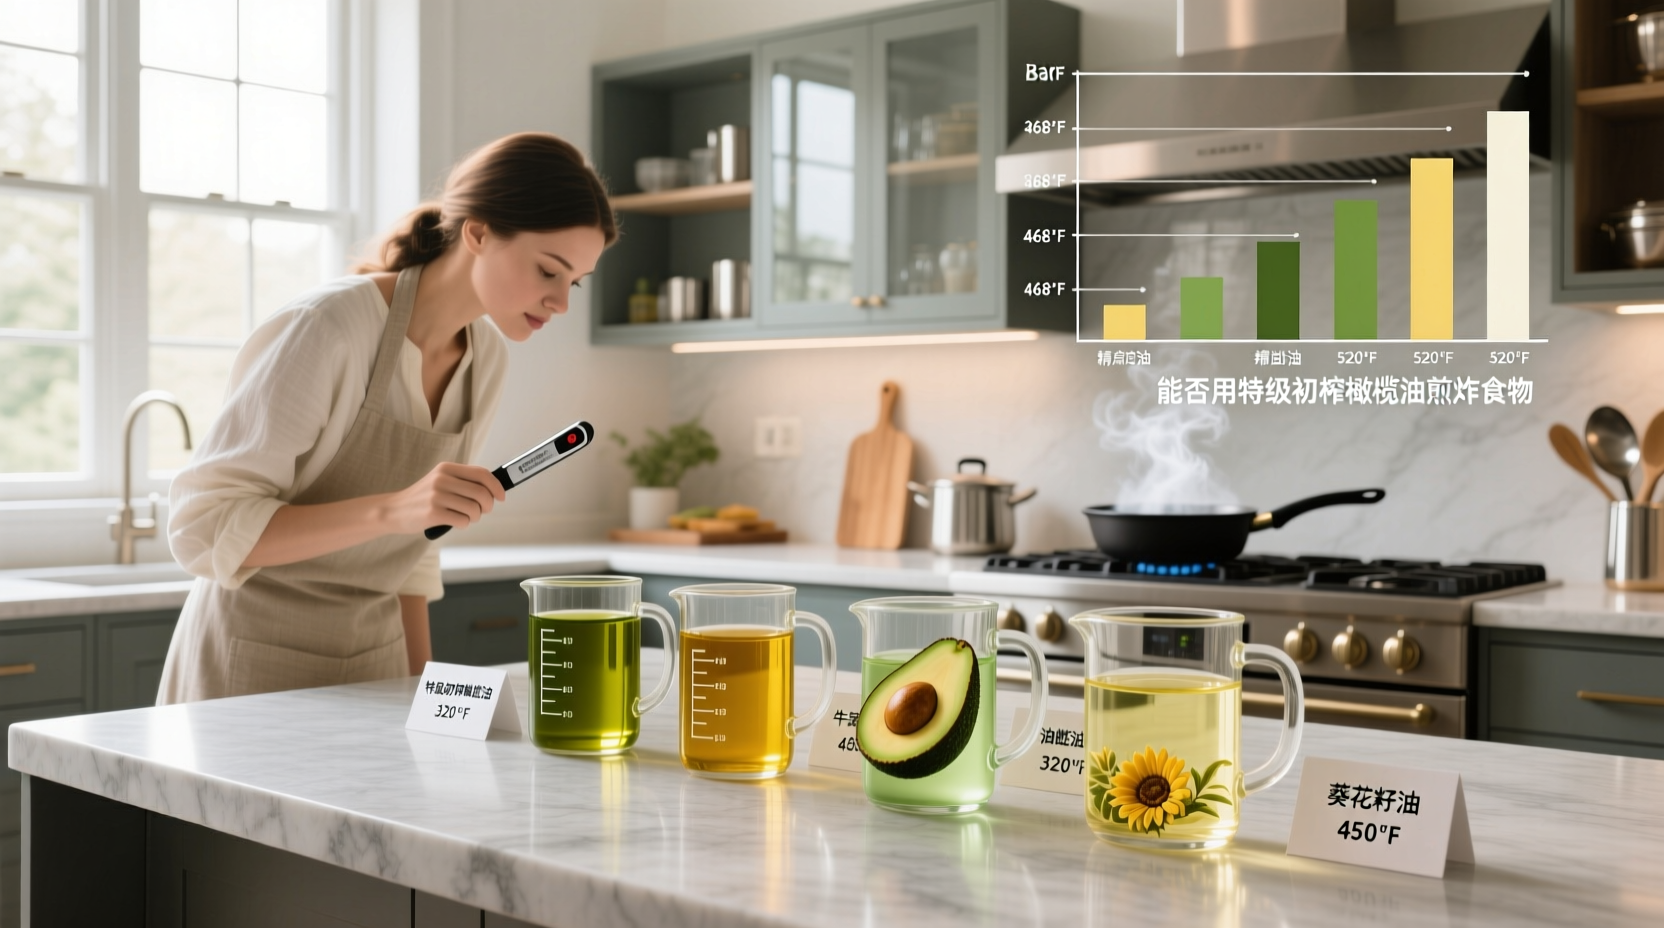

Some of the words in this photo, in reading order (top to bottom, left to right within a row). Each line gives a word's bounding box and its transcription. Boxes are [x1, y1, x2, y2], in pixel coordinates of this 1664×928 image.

[434, 704, 471, 720] 320°F
[1327, 782, 1421, 816] 葵花籽油
[1337, 820, 1401, 845] 450°F
